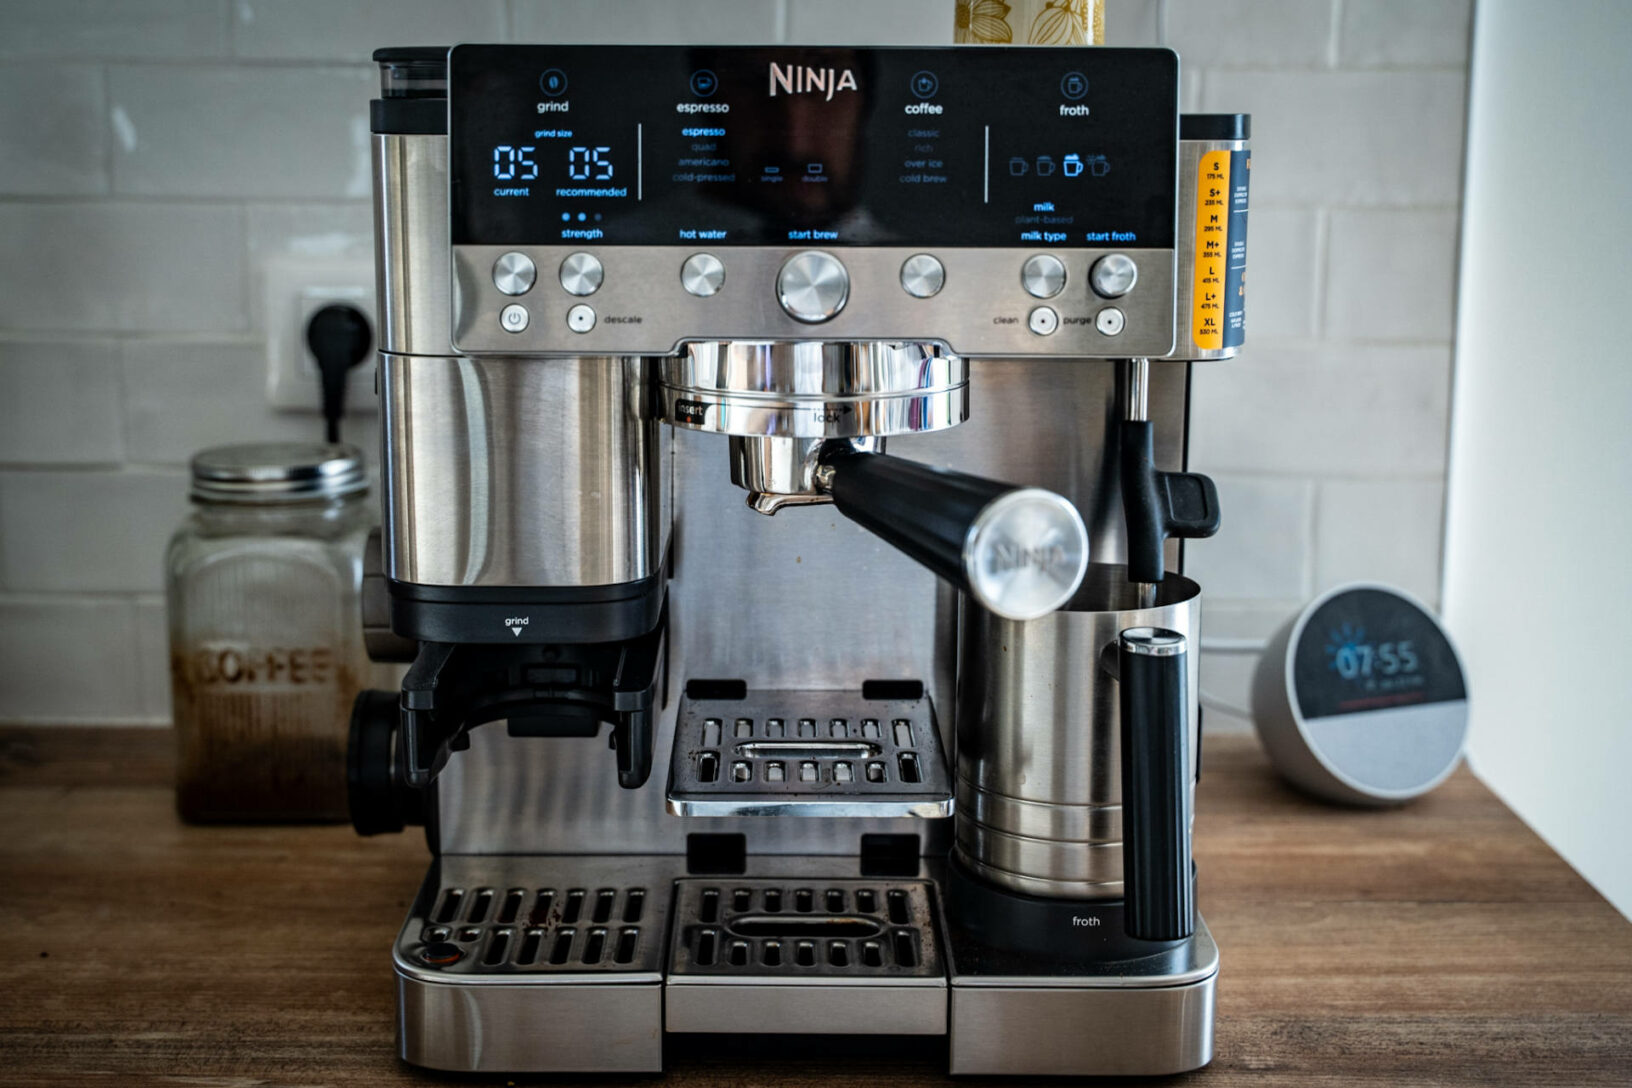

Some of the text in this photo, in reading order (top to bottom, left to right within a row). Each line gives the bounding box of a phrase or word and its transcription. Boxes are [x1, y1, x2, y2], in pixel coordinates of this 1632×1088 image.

[769, 62, 858, 102] NINJA
[537, 101, 569, 113] grind
[676, 103, 730, 115] espresso
[905, 102, 943, 115] coffee
[1059, 105, 1090, 116] froth
[534, 130, 556, 138] grind
[681, 128, 726, 138] espresso
[908, 129, 940, 138] classic
[691, 143, 717, 153] quad
[914, 144, 934, 153] rich
[494, 146, 538, 180] 05
[569, 147, 614, 180] 05
[678, 158, 730, 167] americano
[928, 159, 944, 168] ice
[1213, 162, 1220, 171] S
[672, 174, 736, 183] cold-pressed
[900, 174, 947, 183] cold brew
[493, 188, 529, 196] current
[556, 188, 627, 197] recommended
[1210, 188, 1221, 197] S+
[1033, 203, 1055, 212] milk
[1015, 215, 1074, 224] plant-based
[1211, 214, 1218, 223] M
[561, 229, 603, 240] strength
[679, 229, 727, 239] hot water
[788, 229, 838, 239] start brew
[1021, 231, 1067, 242] milk type
[1086, 231, 1137, 241] start froth
[1206, 241, 1219, 249] M+
[1209, 266, 1215, 275] L
[1206, 292, 1216, 301] L+
[604, 315, 643, 324] descale
[993, 315, 1019, 324] clean
[1063, 316, 1092, 326] purge
[1204, 318, 1216, 327] XL
[504, 616, 529, 626] grind
[1072, 916, 1101, 926] froth
